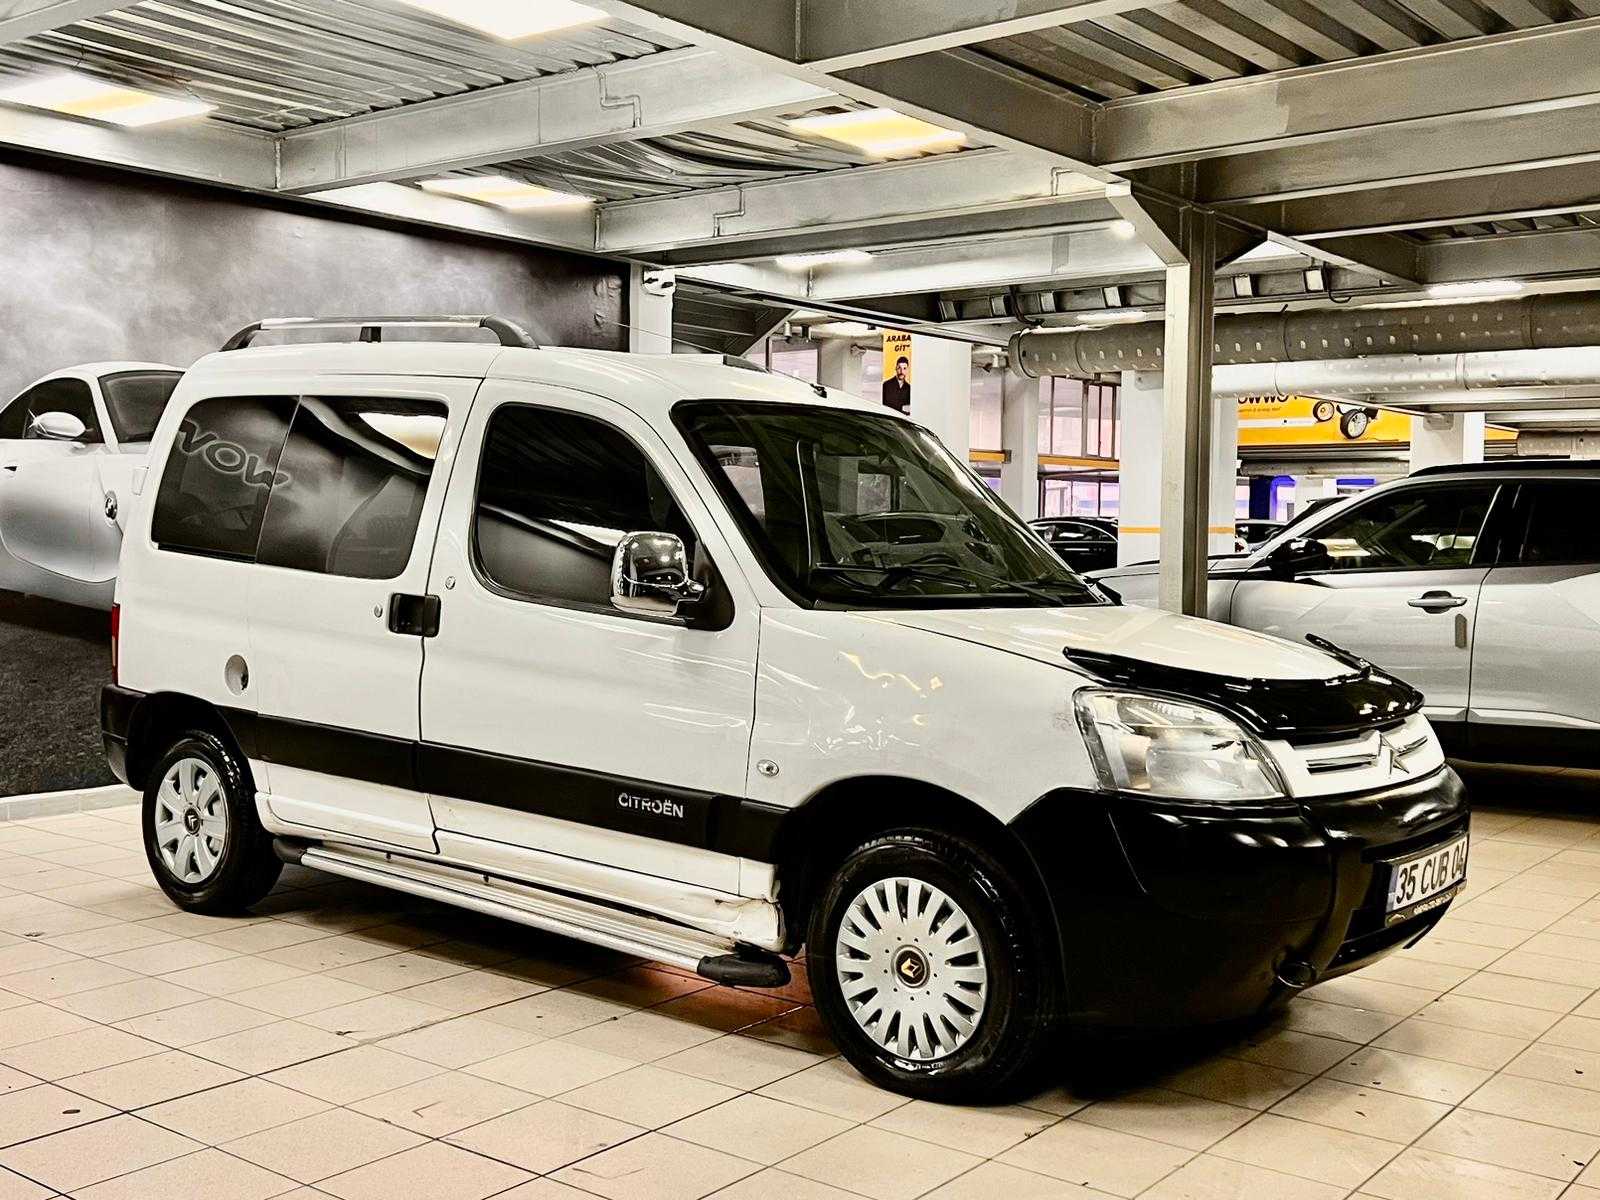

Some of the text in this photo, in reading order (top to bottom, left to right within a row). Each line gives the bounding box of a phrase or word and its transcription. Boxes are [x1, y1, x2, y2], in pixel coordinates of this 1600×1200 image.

[618, 792, 684, 818] CITROËN
[1396, 864, 1418, 904] 35
[1420, 851, 1449, 894] CUB
